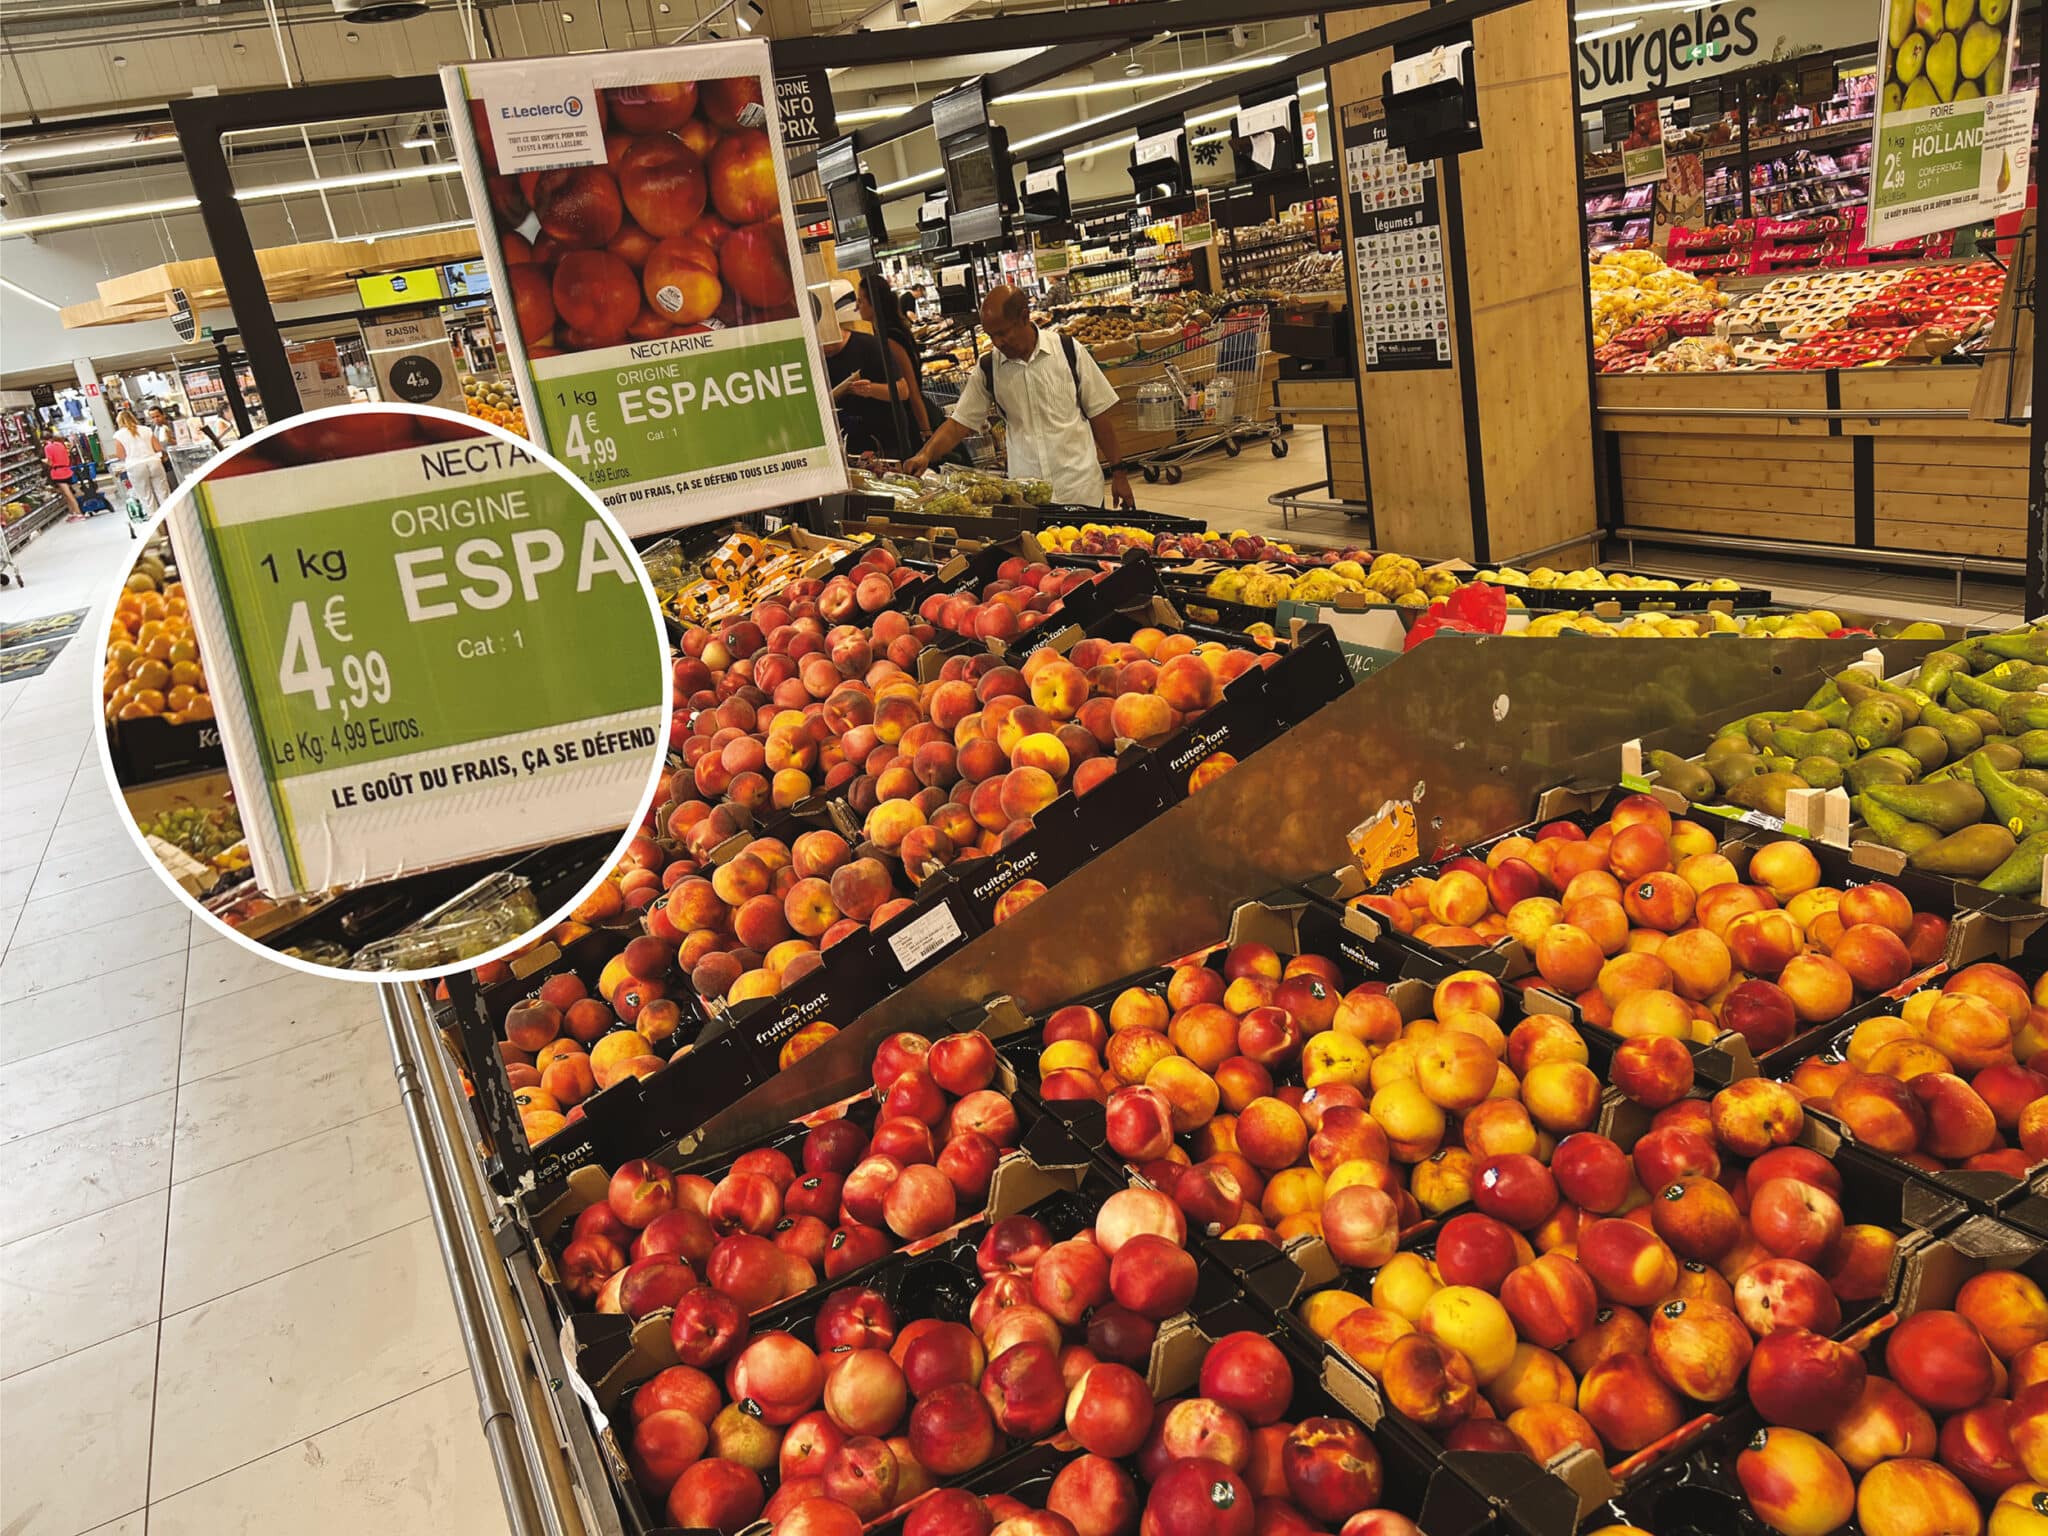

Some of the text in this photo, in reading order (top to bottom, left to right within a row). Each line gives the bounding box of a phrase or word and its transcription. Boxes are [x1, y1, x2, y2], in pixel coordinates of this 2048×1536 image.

[1579, 4, 1758, 90] Surgelés
[501, 103, 564, 119] E.Leclerc
[1914, 121, 1944, 135] ORIGINE
[1930, 104, 1954, 118] POIRE
[1374, 216, 1414, 233] légumes
[385, 325, 419, 337] RAISIN
[630, 334, 714, 360] NECTARINE
[616, 364, 680, 387] ORIGINE
[556, 390, 598, 407] 1 kg
[617, 362, 808, 425] ESPAGNE
[646, 429, 665, 442] Cat
[421, 441, 537, 480] NECTA
[603, 457, 808, 507] GOÛT DU FRAIS, ÇA SE DÉFEND TOUS LES JOURS
[391, 490, 530, 538] ORIGINE
[260, 548, 348, 583] 1 kg
[394, 519, 638, 623] ESPA
[457, 638, 495, 659] Cat
[513, 630, 525, 649] 1
[271, 717, 425, 766] Le Kg: 4,99 Euros.
[1170, 725, 1229, 772] fruites font
[331, 726, 656, 809] LE GOÛT DU FRAIS, ÇA SE DÉFEND
[973, 851, 1038, 899] fruites font
[988, 865, 1033, 898] PREMIUM
[755, 992, 829, 1044] fruites font
[560, 1140, 593, 1165] font
